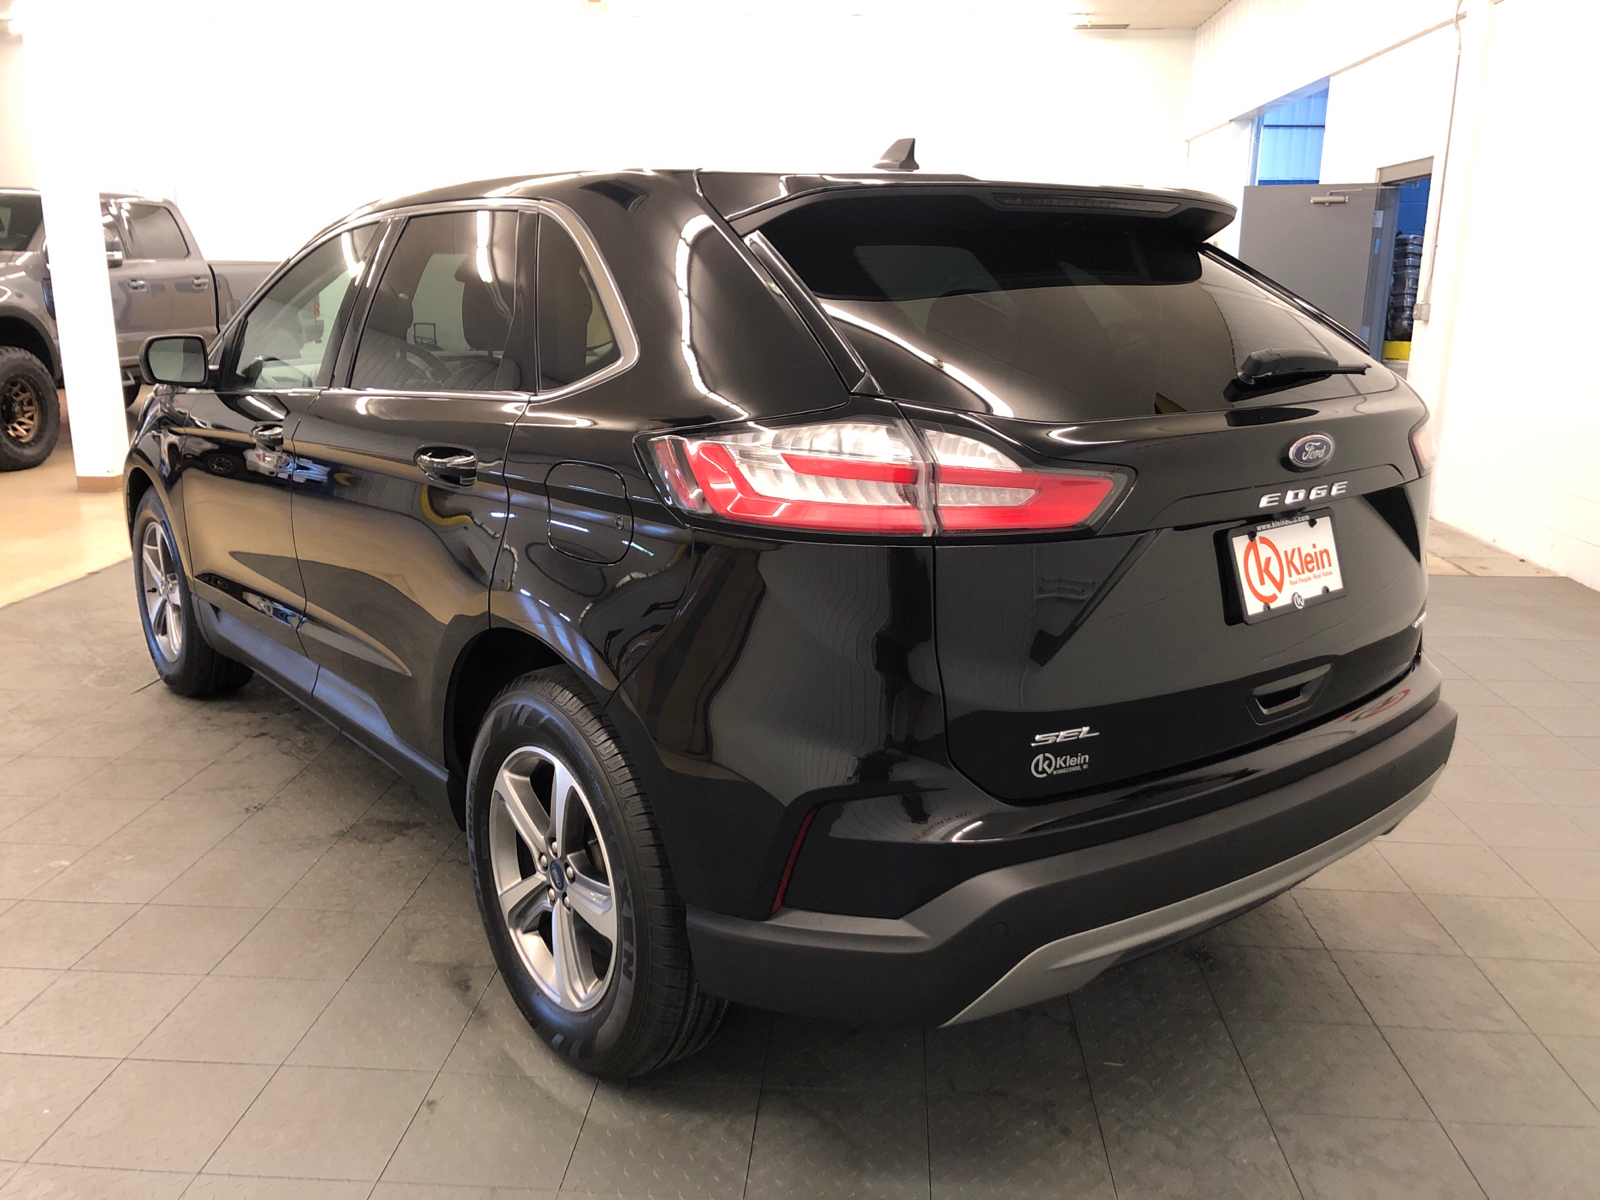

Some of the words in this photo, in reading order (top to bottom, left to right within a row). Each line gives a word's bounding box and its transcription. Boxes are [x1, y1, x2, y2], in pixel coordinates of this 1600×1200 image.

[1301, 441, 1327, 461] Ford
[1259, 481, 1348, 508] EDGE
[1284, 543, 1332, 578] Klein
[1030, 726, 1100, 747] SEL
[1056, 753, 1089, 768] Klein
